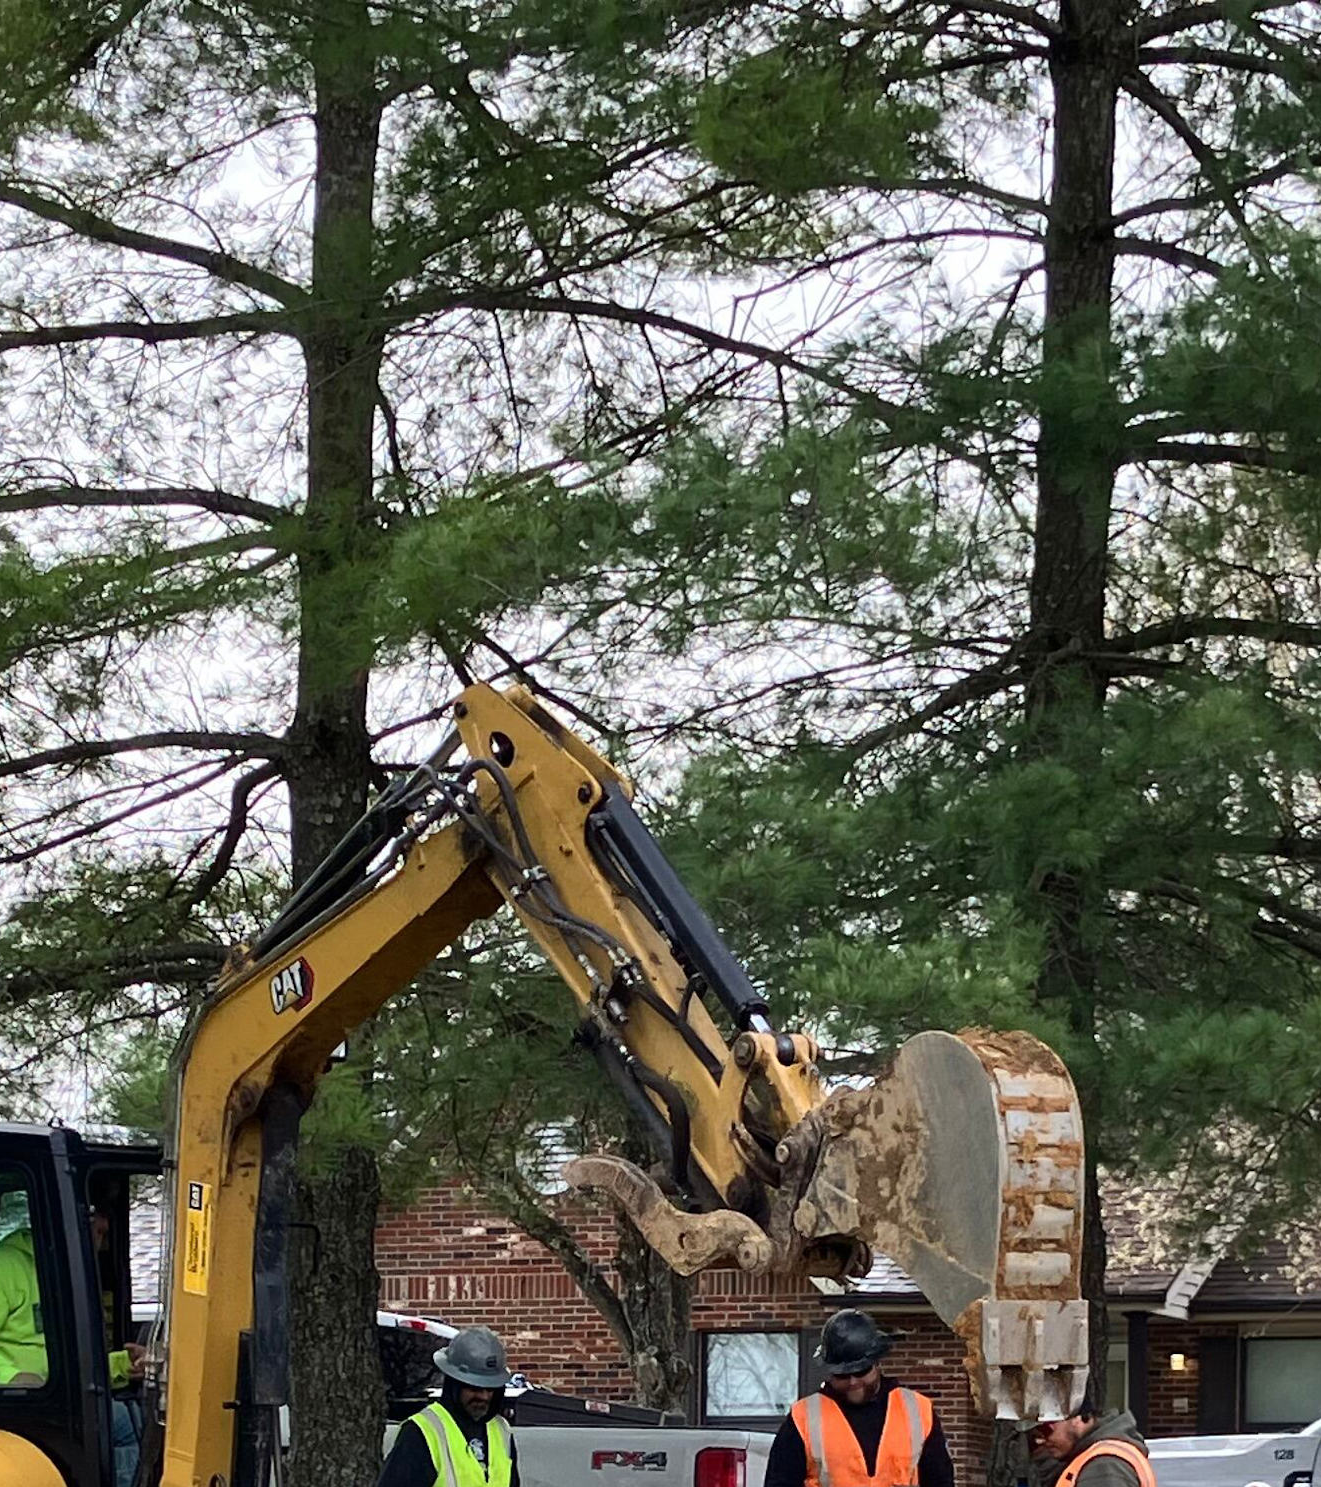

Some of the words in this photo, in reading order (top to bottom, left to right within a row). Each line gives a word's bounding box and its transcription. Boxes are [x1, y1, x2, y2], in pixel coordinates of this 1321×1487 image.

[270, 959, 304, 1014] CAT
[591, 1450, 667, 1471] FX4
[1274, 1450, 1294, 1460] 128
